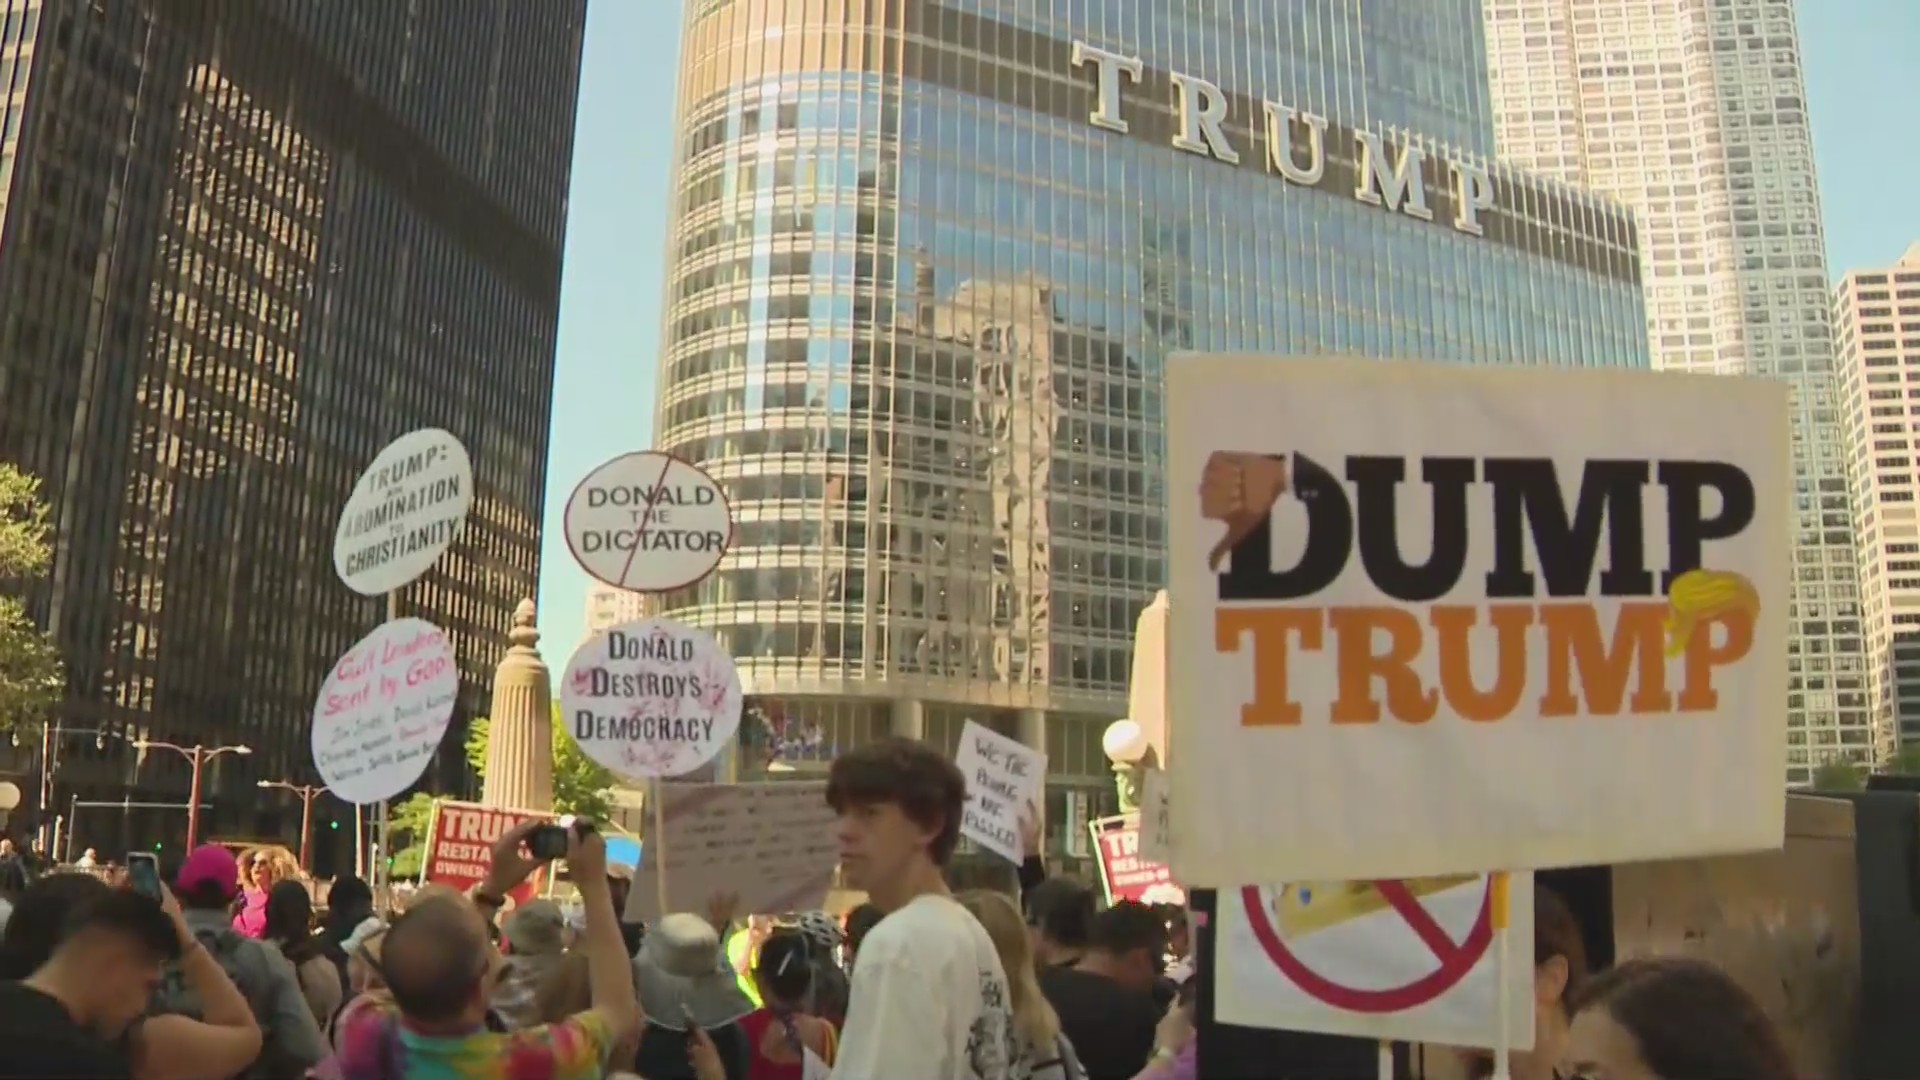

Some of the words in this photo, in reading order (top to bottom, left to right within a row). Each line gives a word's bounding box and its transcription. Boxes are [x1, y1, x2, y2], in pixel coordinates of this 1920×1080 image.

[1071, 40, 1495, 236] TRUMP
[369, 444, 447, 494] TRUMP:
[344, 473, 460, 538] ABOMINATION
[588, 484, 714, 508] DONALD
[629, 509, 671, 524] THE
[1218, 450, 1756, 602] DUMP
[346, 515, 459, 577] CHRISTIANITY
[582, 529, 724, 553] DICTATOR
[608, 630, 694, 662] DONALD
[1215, 599, 1760, 727] TRUMP
[591, 665, 703, 699] DESTROYS
[575, 708, 714, 742] DEMOCRACY
[442, 808, 529, 842] TRUM
[437, 841, 492, 863] RESTA
[435, 862, 489, 879] OWNER-
